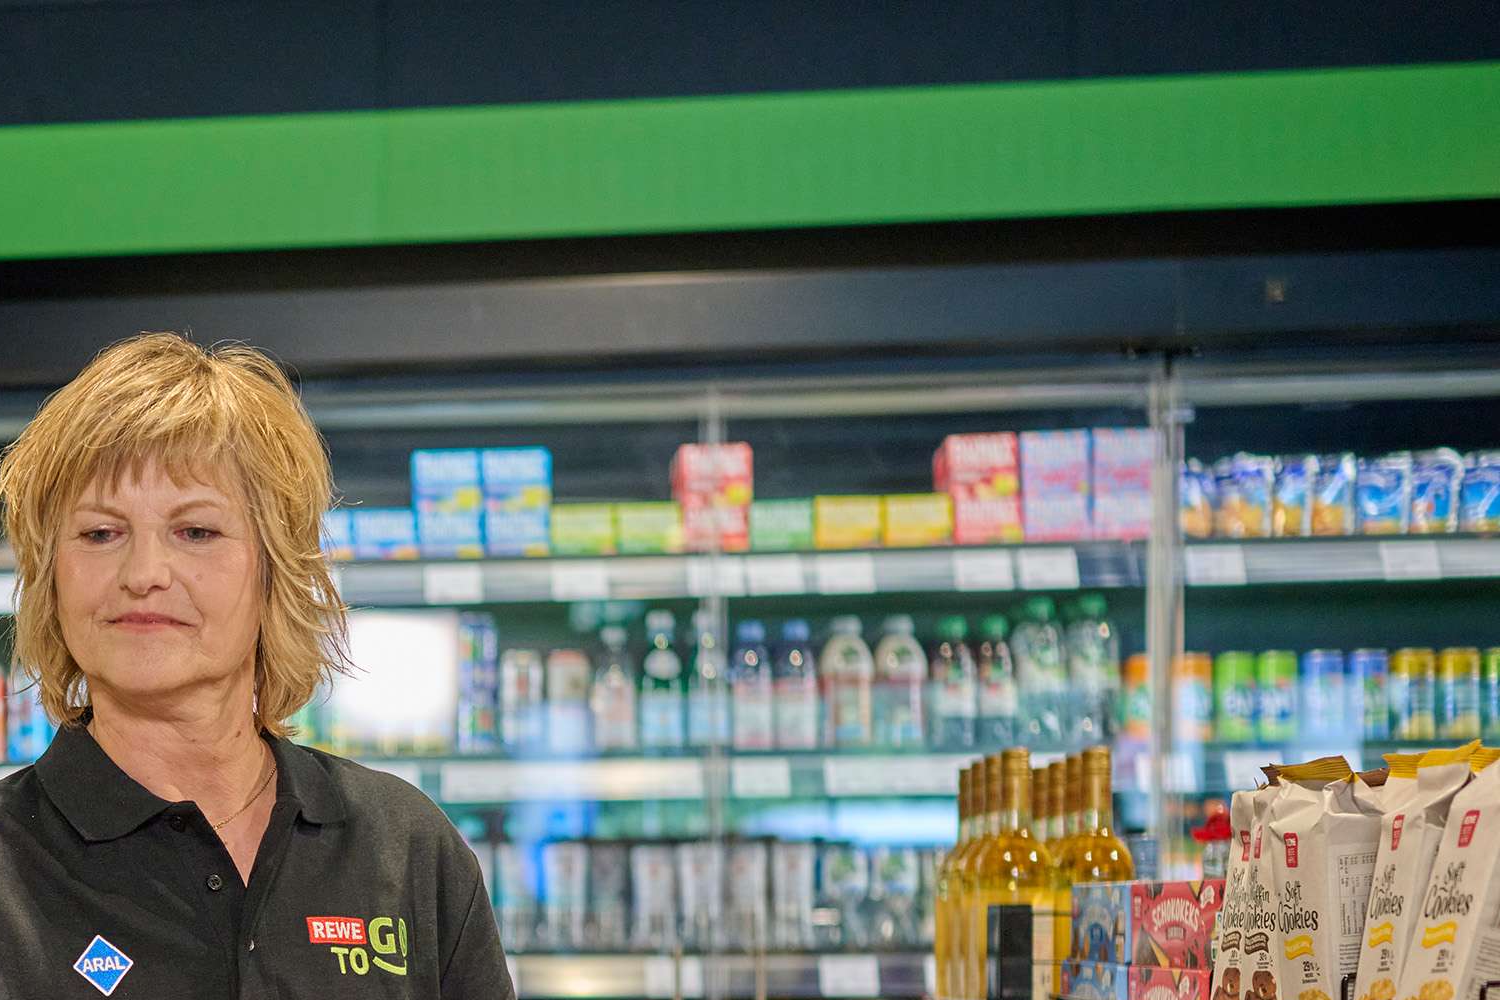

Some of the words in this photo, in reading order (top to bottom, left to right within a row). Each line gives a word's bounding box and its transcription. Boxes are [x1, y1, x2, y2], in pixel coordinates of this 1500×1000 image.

[1285, 881, 1302, 904] Soft
[1222, 903, 1244, 929] Cookie
[1278, 901, 1318, 934] Cookies
[312, 921, 363, 940] REWE
[83, 956, 127, 973] ARAL
[331, 947, 370, 975] TO
